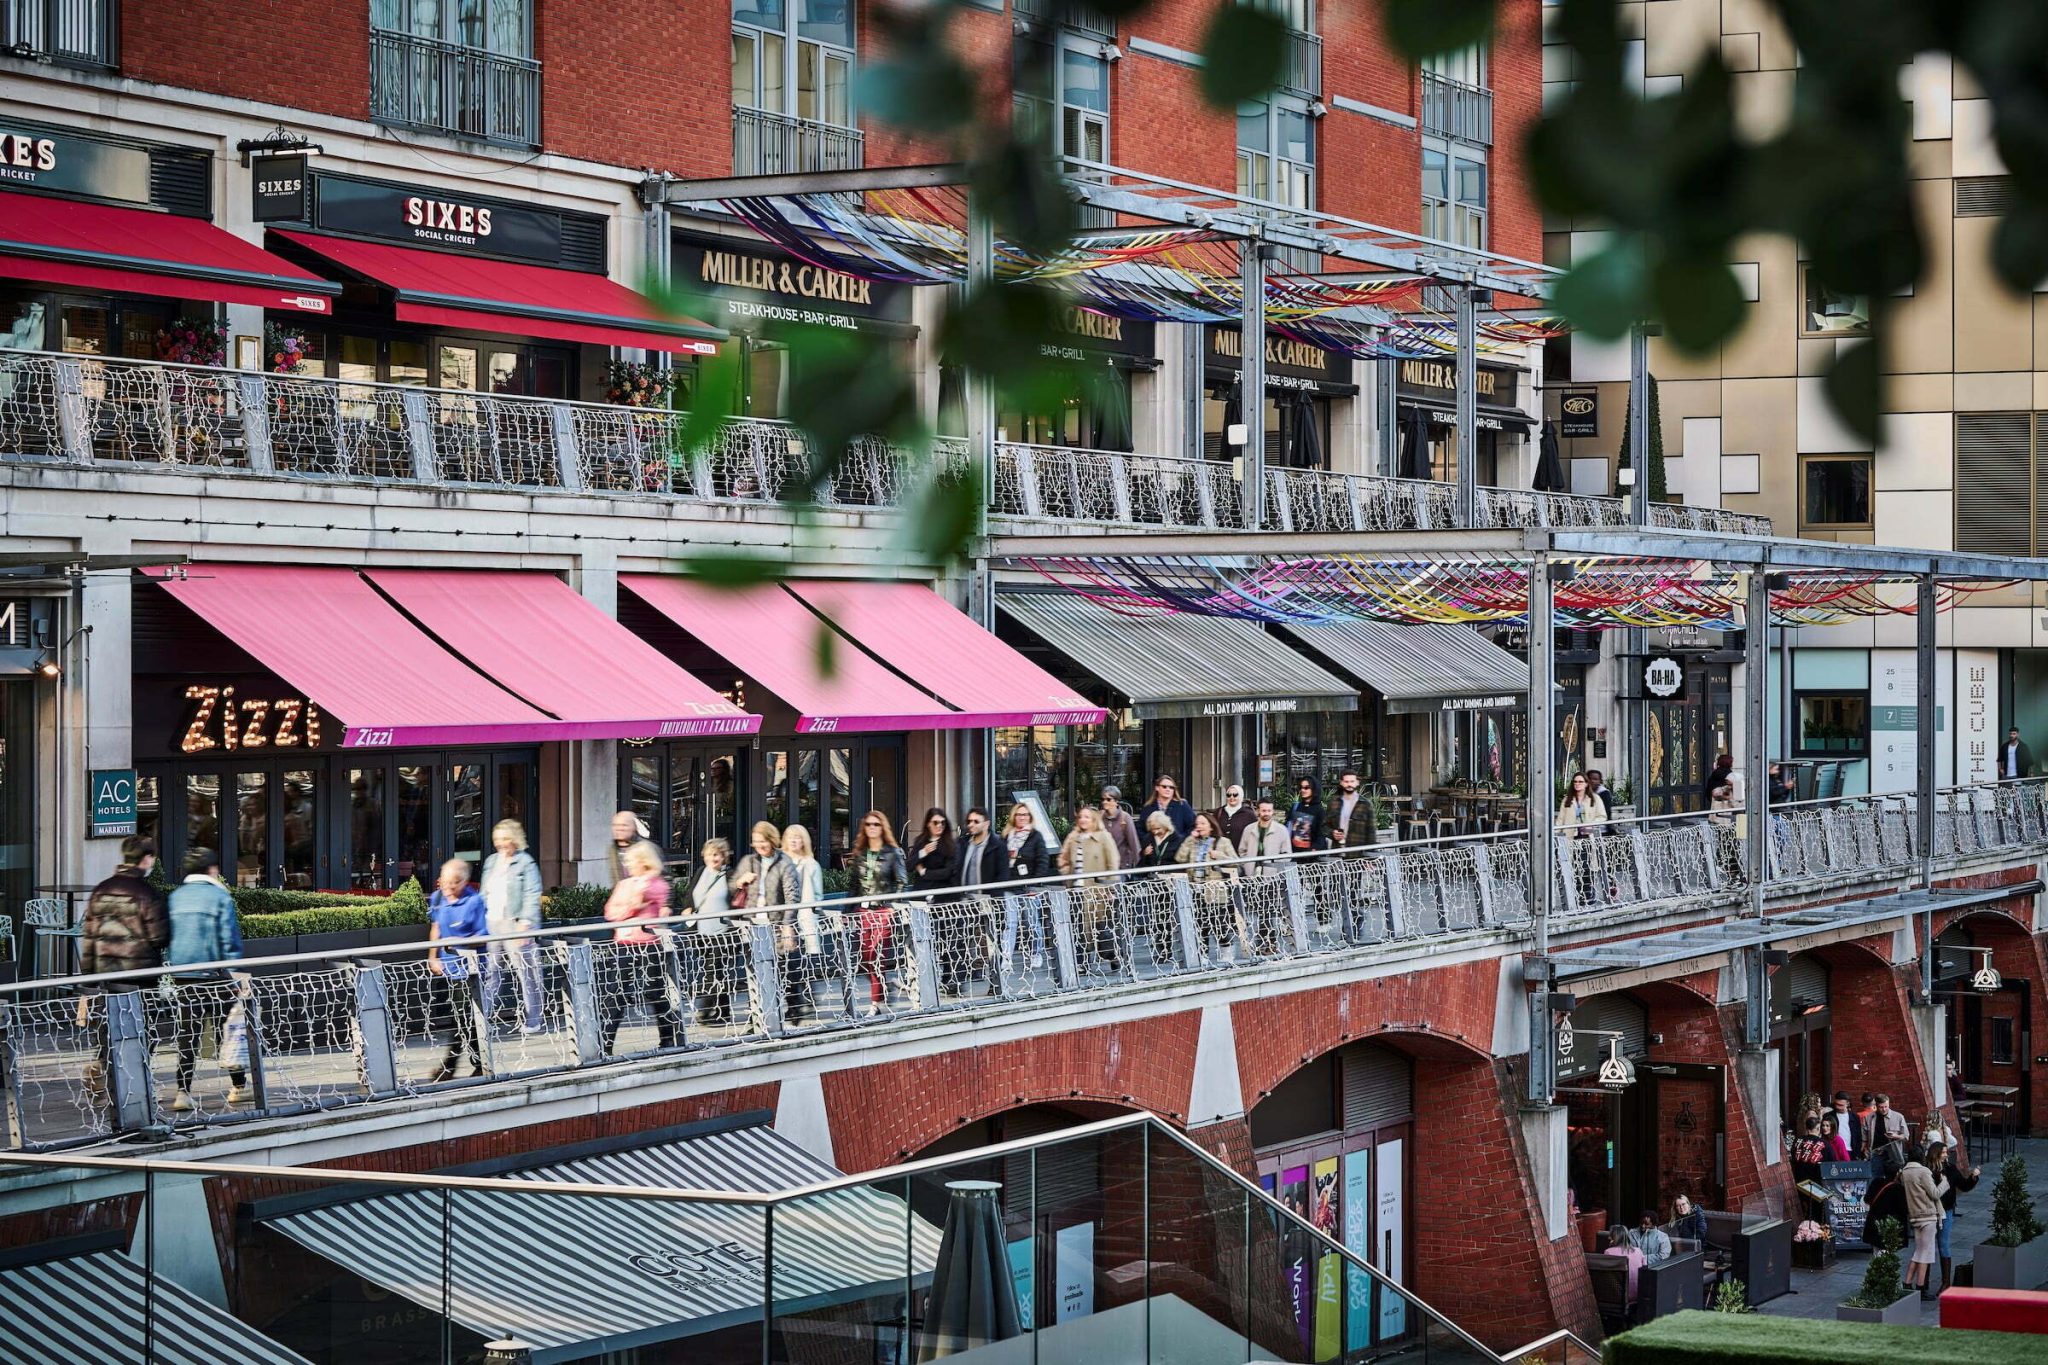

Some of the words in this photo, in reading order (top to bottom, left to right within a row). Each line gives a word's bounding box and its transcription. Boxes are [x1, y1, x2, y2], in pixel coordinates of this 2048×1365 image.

[258, 179, 302, 193] SIXES
[406, 196, 492, 237] SIXES
[414, 229, 443, 240] SOCIAL
[444, 233, 476, 246] CRICKET
[702, 250, 776, 292] MILLER
[779, 261, 798, 295] &
[797, 265, 872, 305] CARTER
[300, 299, 321, 308] SIXES
[728, 300, 799, 322] STEAKHOUSE
[804, 310, 826, 326] BAR
[829, 313, 859, 330] GRILL
[1064, 305, 1123, 341] CARTER
[1040, 344, 1058, 358] BAR
[1061, 346, 1086, 361] GRILL
[1214, 329, 1243, 358] MIL
[1265, 336, 1278, 363] &
[1276, 338, 1326, 370] CARTER
[1402, 360, 1444, 388] MILLER
[1444, 365, 1456, 390] &
[1283, 377, 1299, 389] BAR
[1300, 378, 1320, 391] GRILL
[1486, 419, 1504, 430] GRILL
[1651, 669, 1676, 686] BA-HA
[1887, 682, 1894, 690] 8
[1442, 700, 1453, 710] ALL
[1453, 699, 1464, 709] DAY
[1464, 698, 1483, 709] DINING
[1483, 697, 1494, 708] AND
[1970, 667, 1985, 732] CUBE
[1203, 703, 1216, 715] ALL
[1216, 702, 1231, 715] DAY
[1231, 701, 1254, 714] DINING
[1255, 701, 1269, 712] AND
[1887, 711, 1893, 719] 7
[181, 685, 322, 754] Zizzi
[809, 717, 839, 733] Zizzi
[1067, 711, 1099, 724] ITALIAN
[658, 721, 708, 735] INDIVIDUALLY
[708, 719, 750, 733] ITALIAN
[354, 729, 394, 746] Zizzi
[1887, 763, 1894, 771] 5
[99, 780, 131, 804] AC
[98, 807, 131, 815] HOTELS
[98, 826, 132, 834] MARRIOTT
[1679, 960, 1700, 974] ALUNA
[1834, 1206, 1866, 1214] BRUNCH
[628, 1240, 764, 1278] CÔTE
